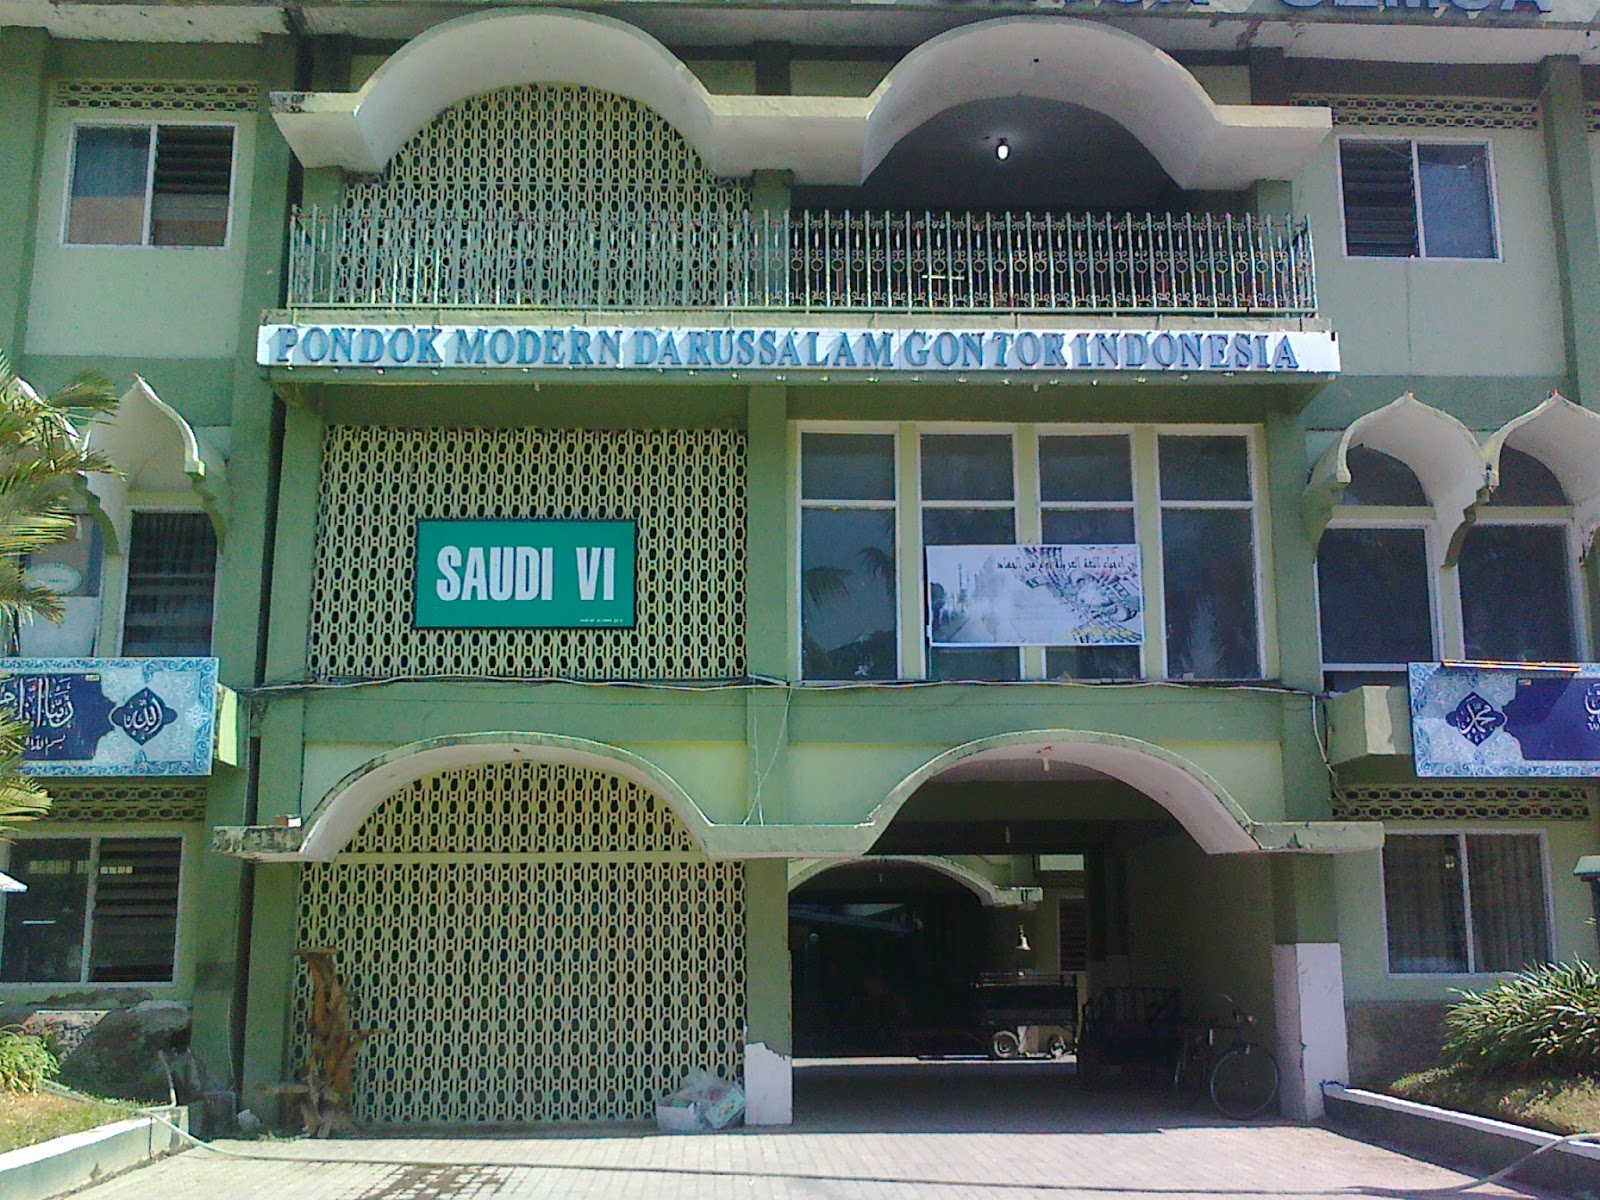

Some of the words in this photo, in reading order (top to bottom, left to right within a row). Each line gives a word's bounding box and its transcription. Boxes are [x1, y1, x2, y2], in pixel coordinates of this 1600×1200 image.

[276, 326, 443, 365] PONDOK
[454, 327, 622, 366] MODERN
[633, 329, 895, 368] DARUSSALAM
[903, 330, 1066, 368] GONTOR
[1075, 331, 1301, 369] INDONESIA
[436, 545, 553, 601] SAUDI
[575, 547, 615, 601] VI
